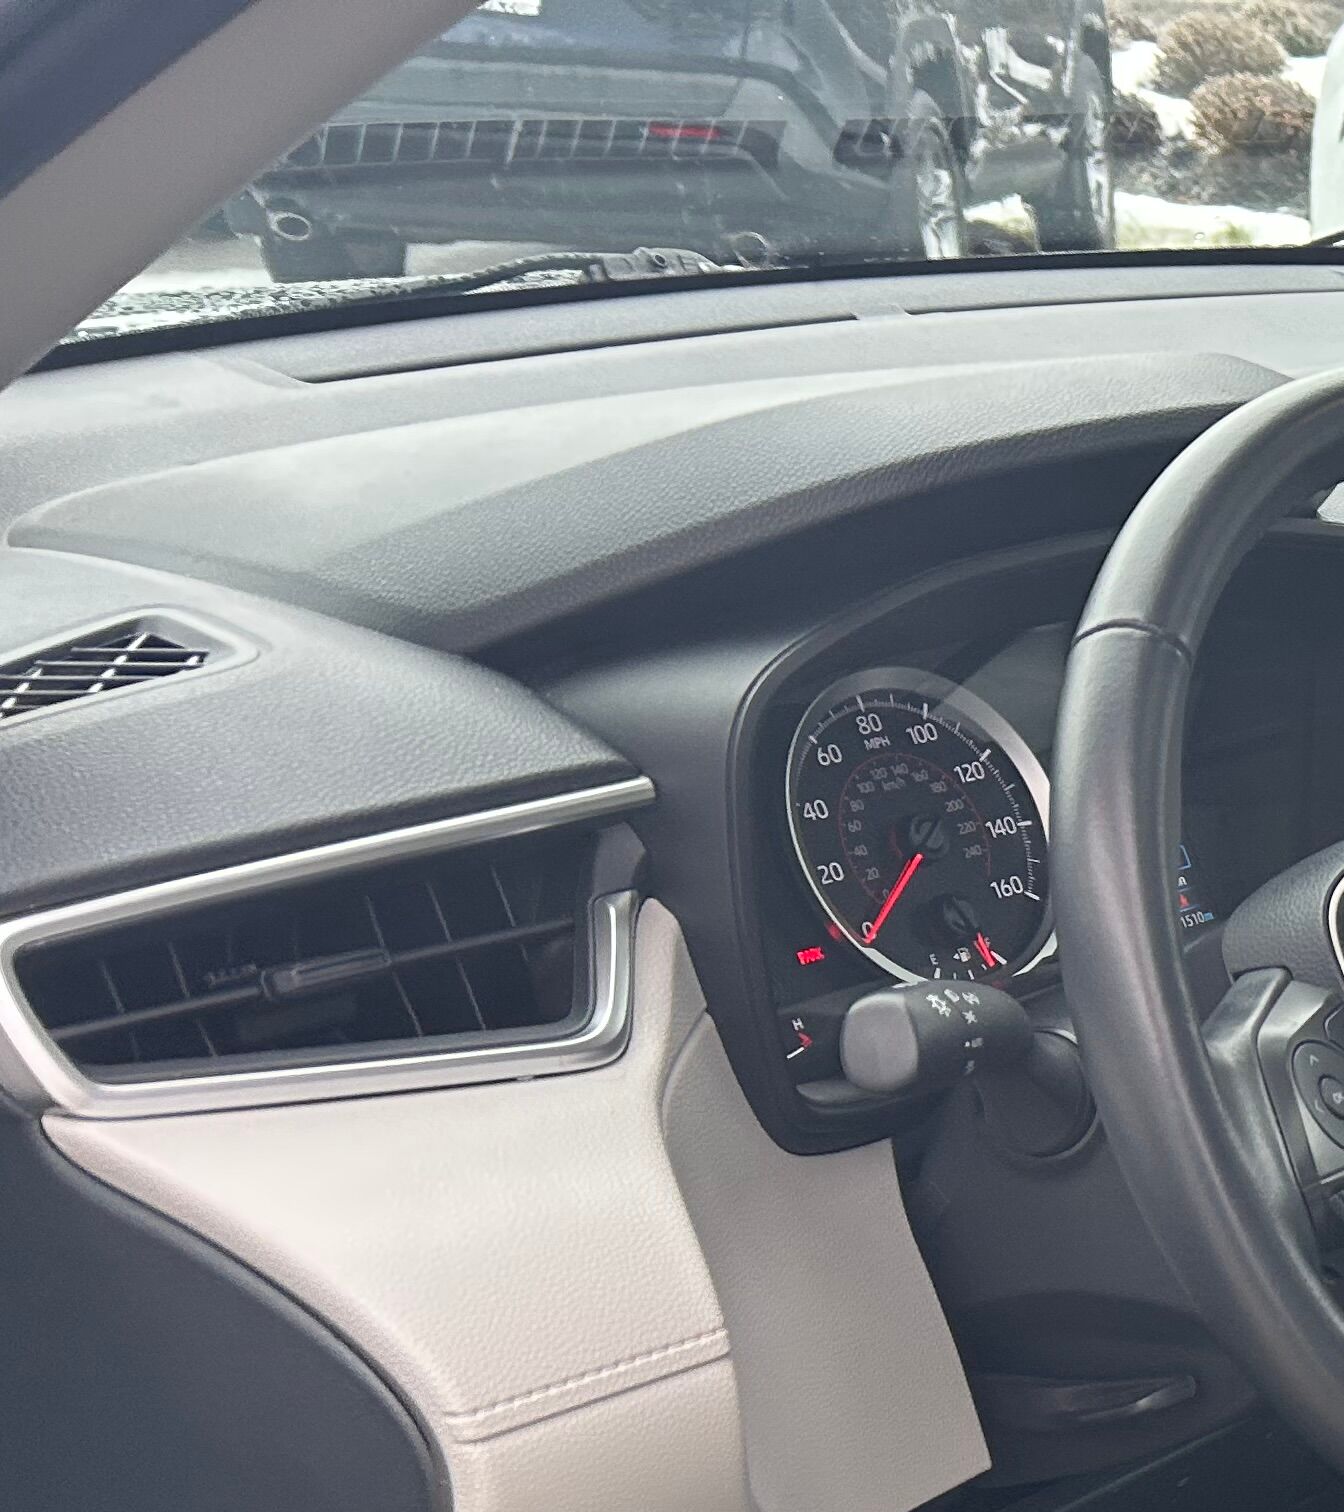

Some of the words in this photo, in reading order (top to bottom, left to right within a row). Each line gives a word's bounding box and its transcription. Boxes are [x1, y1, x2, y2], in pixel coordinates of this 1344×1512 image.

[855, 713, 883, 735] 80
[906, 722, 938, 745] 100
[864, 735, 891, 750] MPH
[817, 744, 843, 766] 60
[954, 761, 986, 783] 120
[803, 800, 829, 820] 40
[986, 816, 1018, 838] 140
[817, 862, 844, 884] 20
[865, 867, 880, 880] 20
[990, 875, 1024, 899] 160
[1181, 911, 1205, 928] 1510
[929, 953, 938, 965] E
[792, 1017, 804, 1030] H
